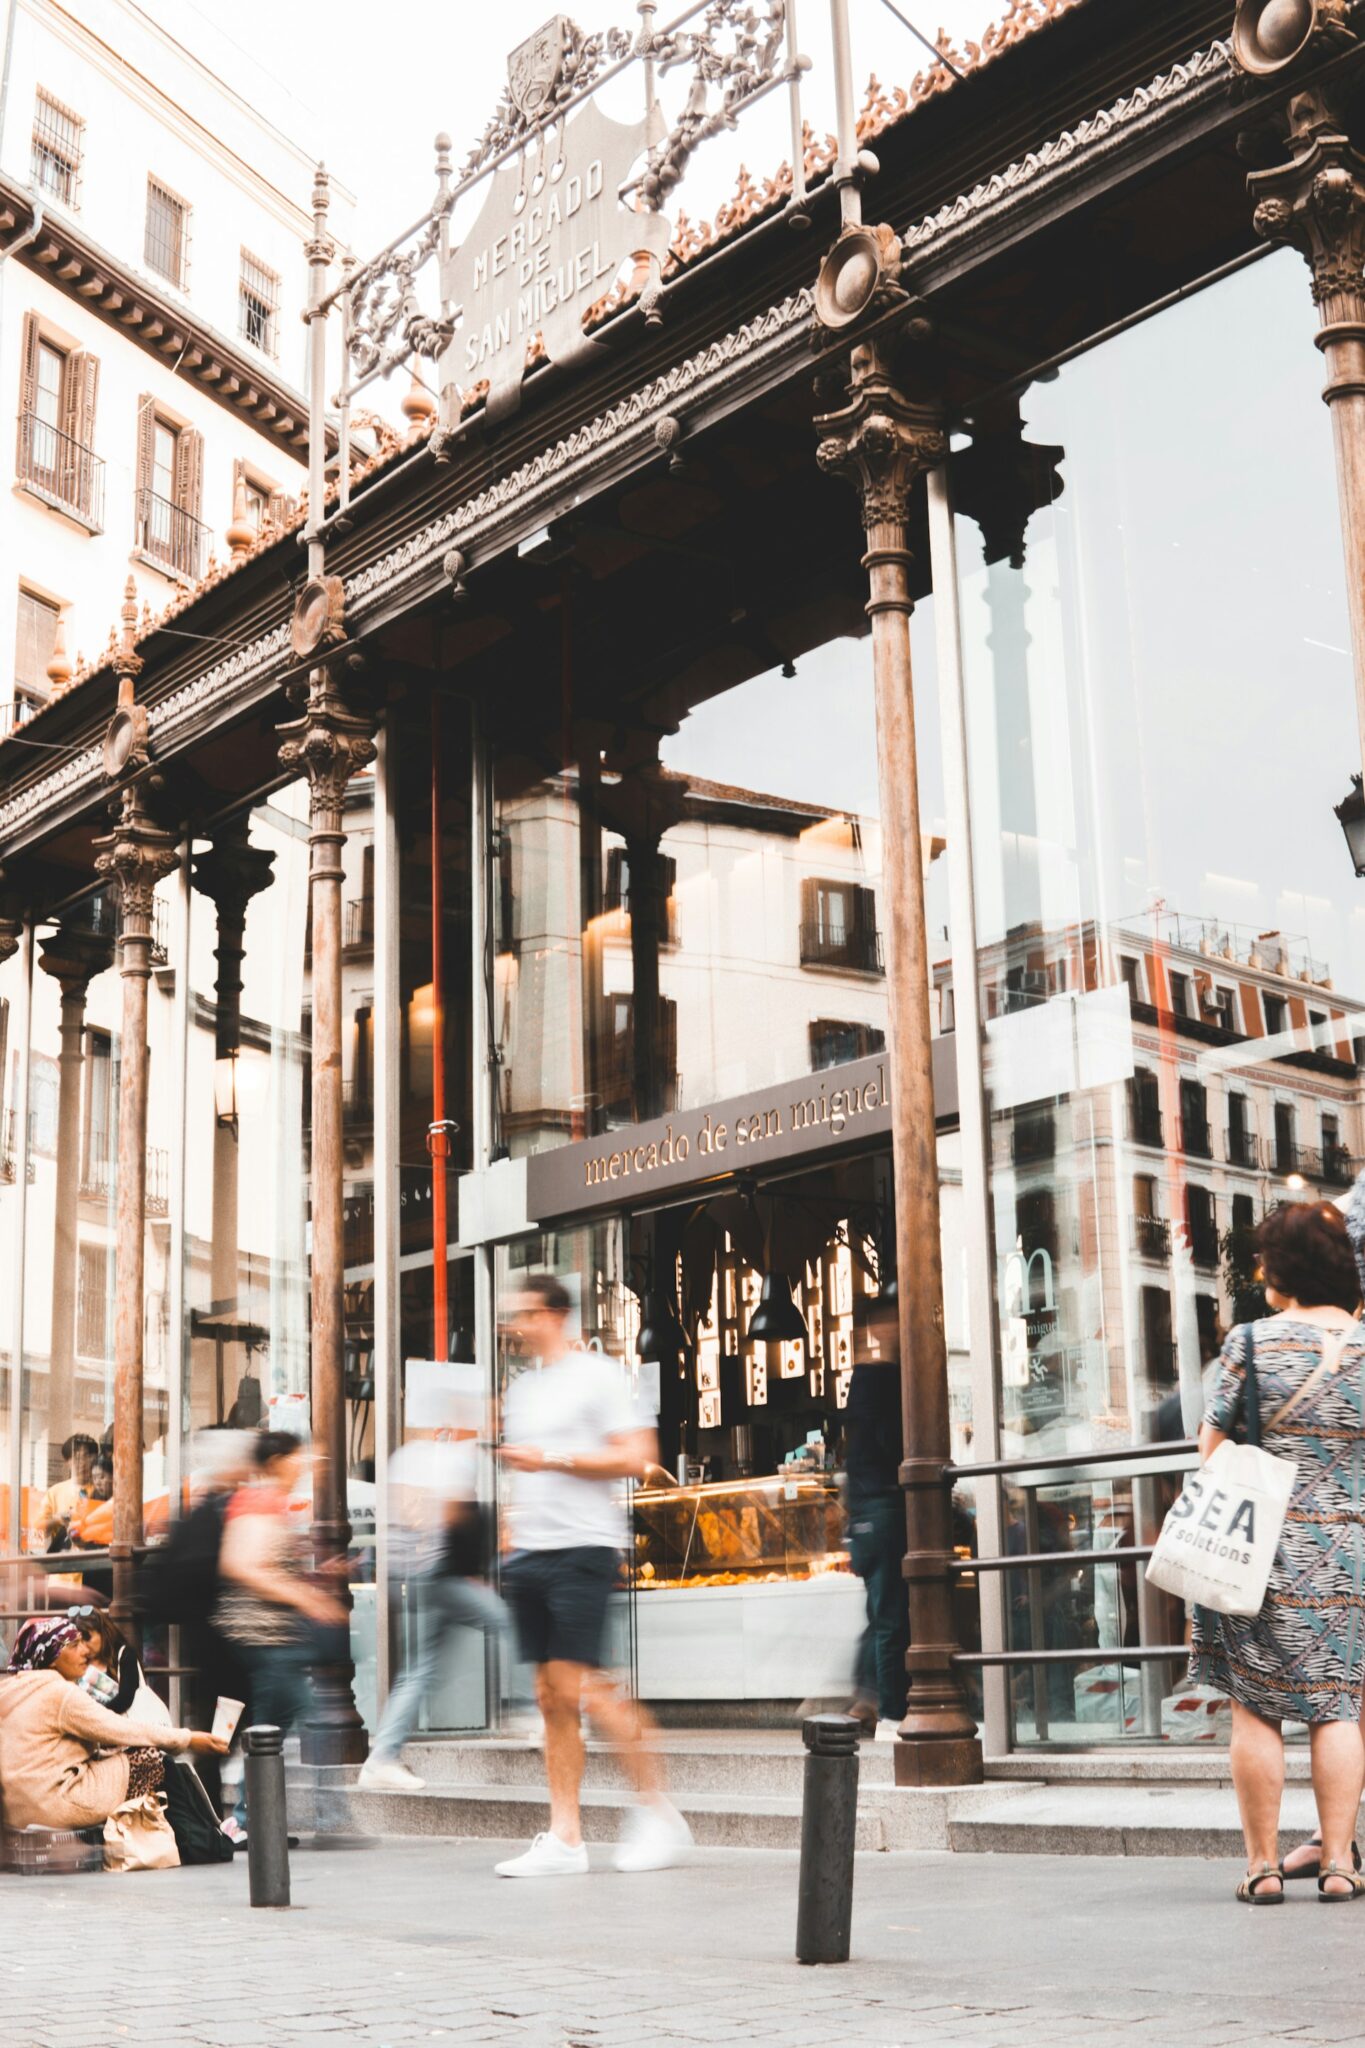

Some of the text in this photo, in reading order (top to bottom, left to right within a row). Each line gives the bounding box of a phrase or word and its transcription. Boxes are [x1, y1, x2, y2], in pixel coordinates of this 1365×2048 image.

[473, 159, 603, 293] MERCADO
[520, 245, 550, 288] DE
[465, 240, 615, 372] SAN MIGUEL
[583, 1064, 891, 1187] mercado de san miguel
[1171, 1480, 1255, 1544] SEA
[1176, 1529, 1251, 1565] solutions
